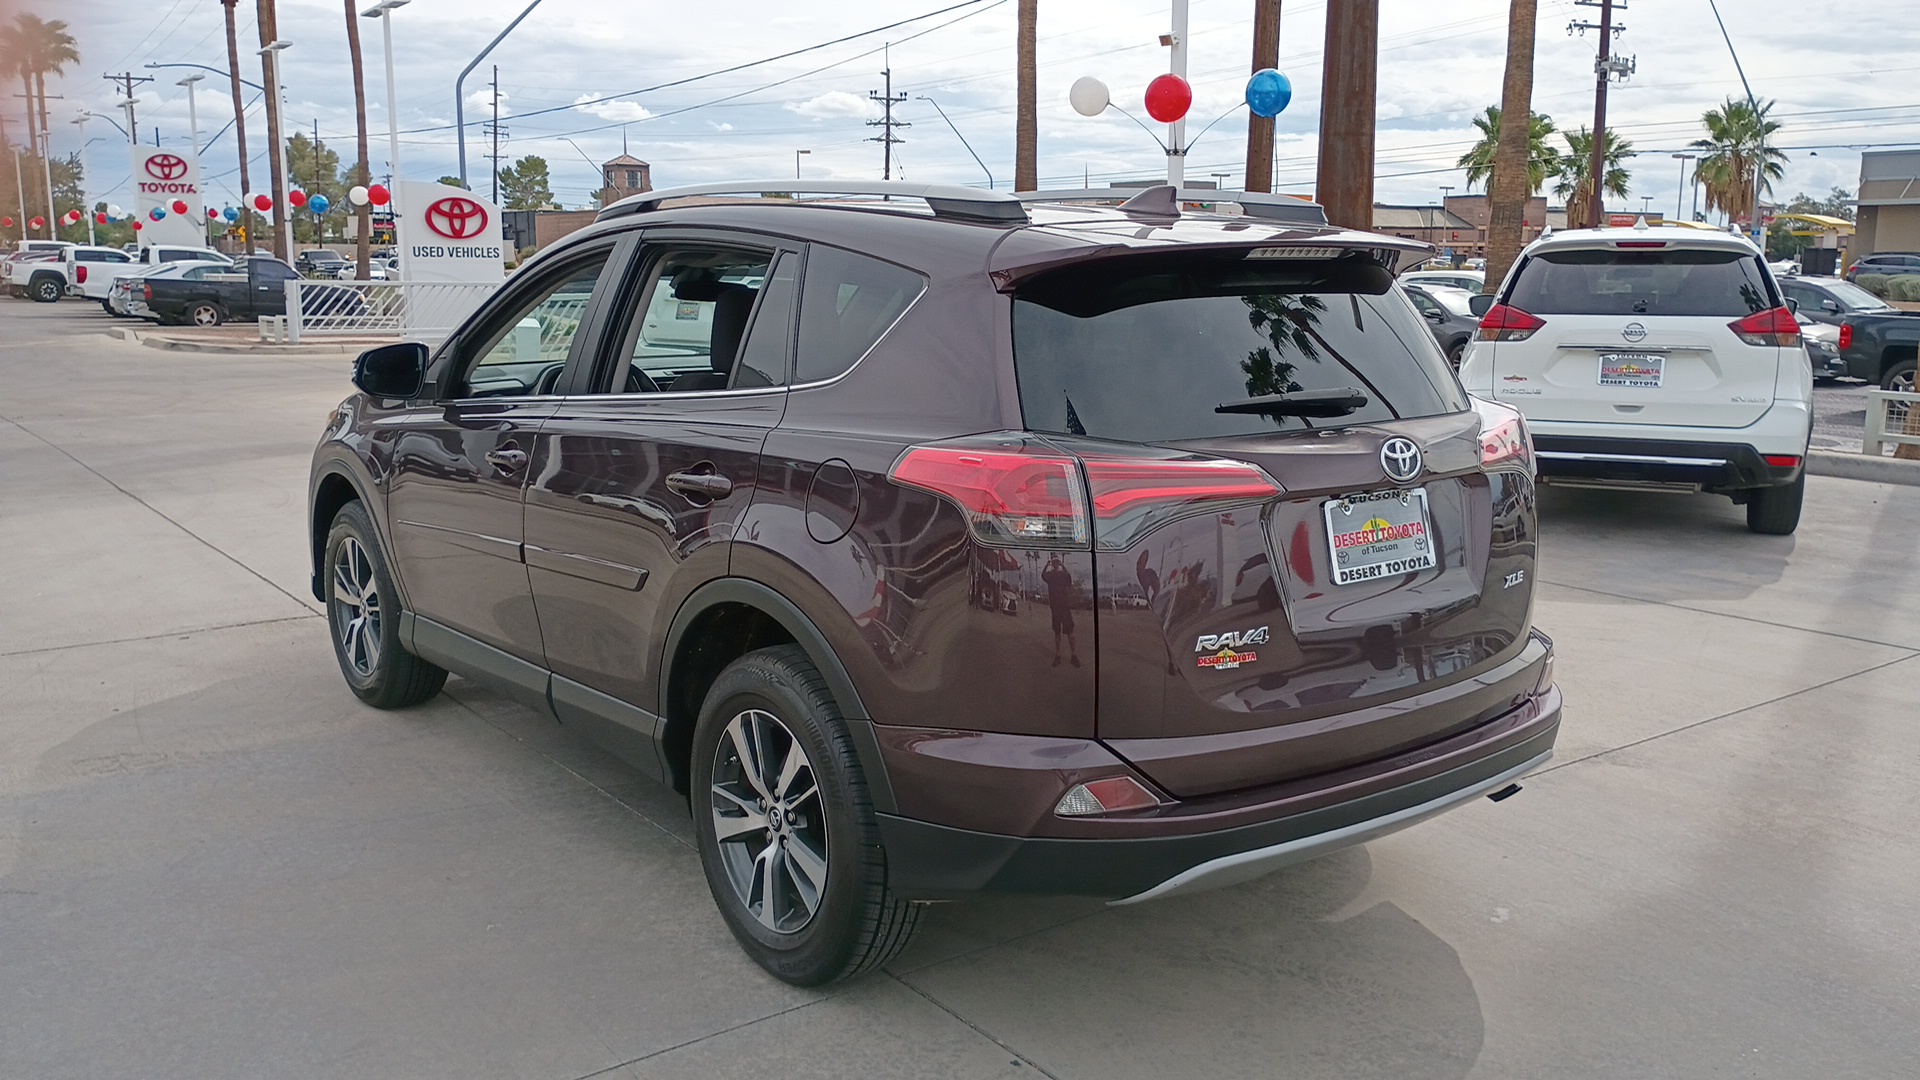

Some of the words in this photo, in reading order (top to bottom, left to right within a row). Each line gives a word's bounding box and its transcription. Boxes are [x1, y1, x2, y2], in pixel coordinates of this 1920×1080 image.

[138, 182, 197, 194] TOYOTA
[413, 246, 444, 258] USED
[447, 246, 500, 259] VEHICLES
[1348, 490, 1401, 504] TUCSON
[1333, 529, 1377, 549] DESERT
[1379, 521, 1424, 540] TOYOTA
[1361, 546, 1370, 556] of
[1371, 543, 1399, 553] Tucson
[1340, 565, 1382, 582] DESERT
[1385, 556, 1431, 574] TOYOTA
[1503, 569, 1525, 589] XLE
[1194, 626, 1270, 652] RAV4
[1197, 656, 1226, 666] DESERT
[1226, 652, 1257, 664] TOYOTA
